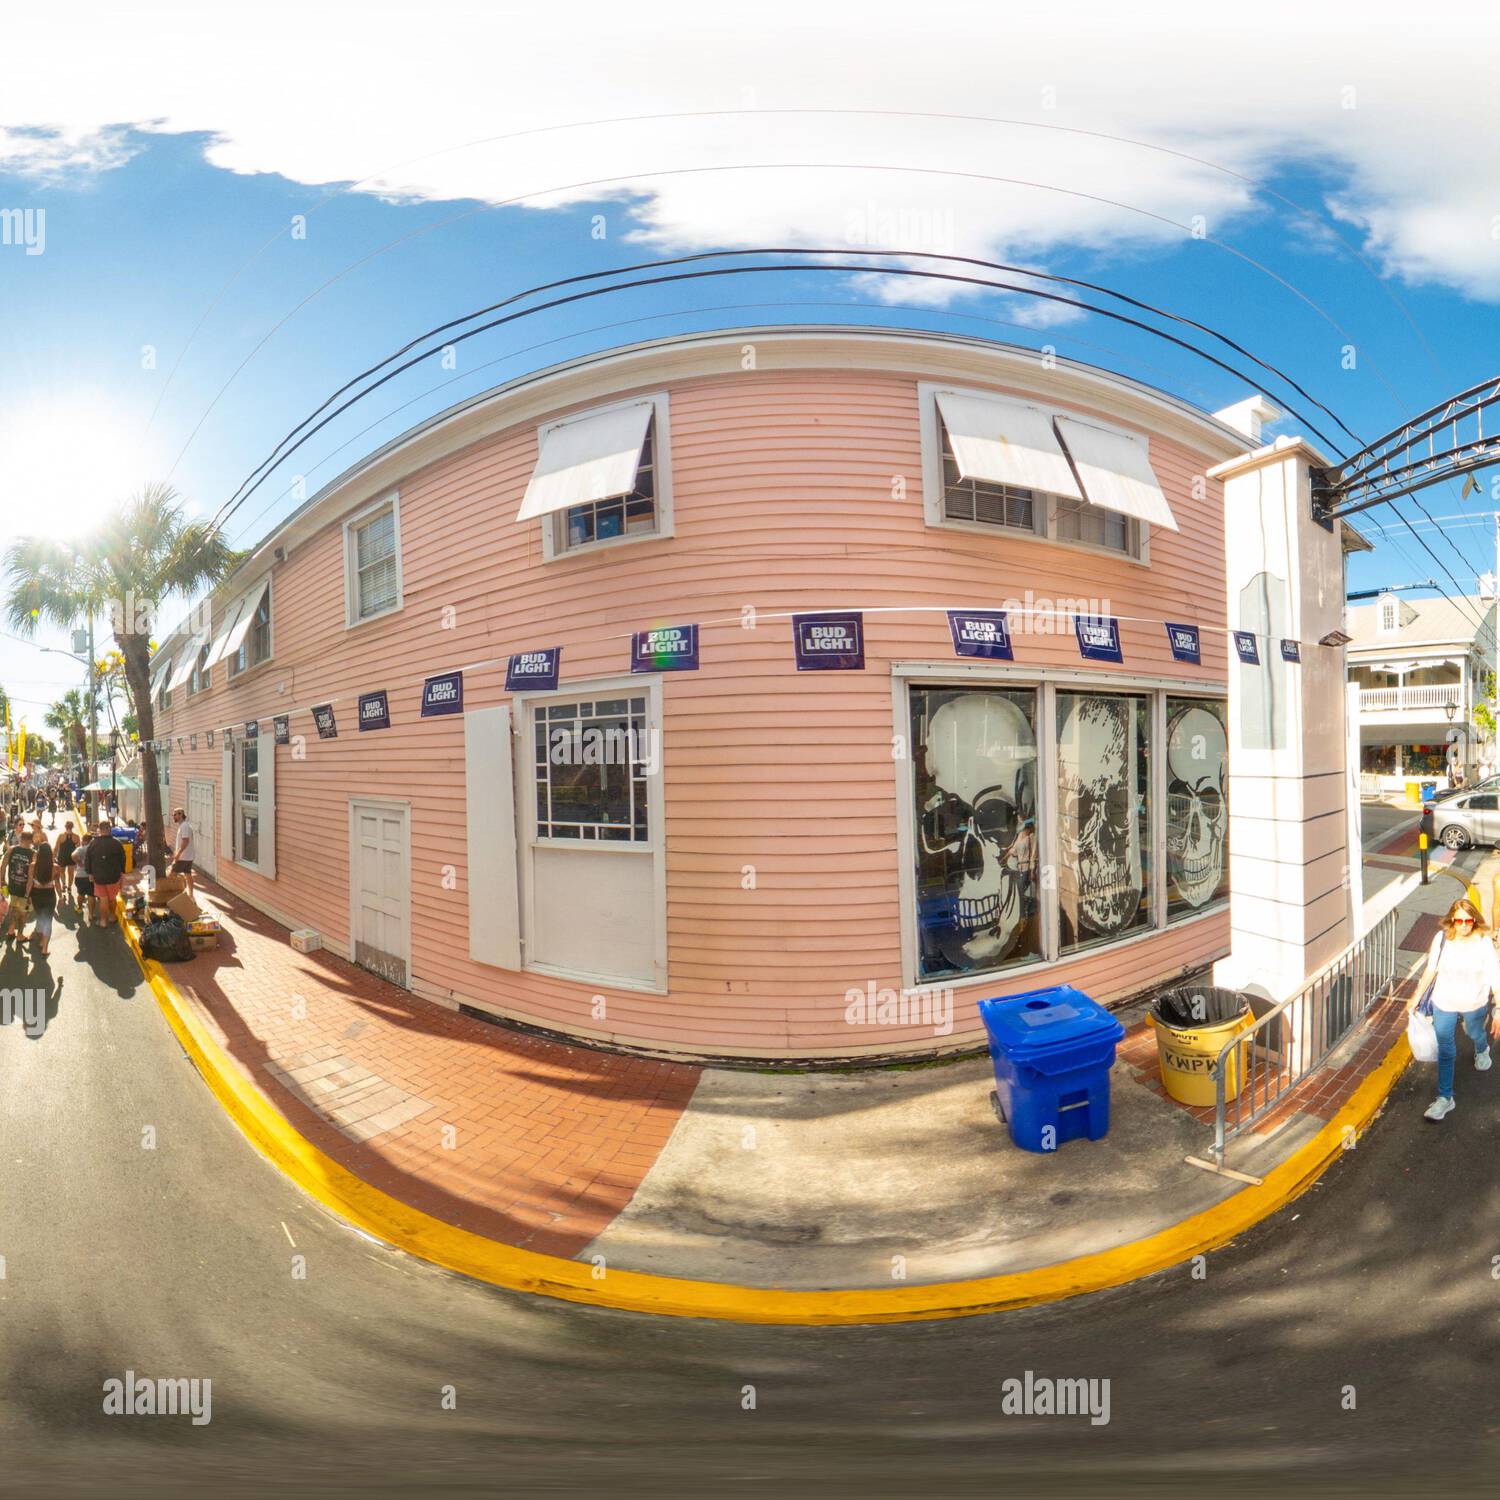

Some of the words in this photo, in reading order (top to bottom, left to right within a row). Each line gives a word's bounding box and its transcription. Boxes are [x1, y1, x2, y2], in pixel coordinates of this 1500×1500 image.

[965, 621, 996, 632] BUD
[1086, 626, 1108, 638] BUD
[648, 629, 681, 642] BUD
[811, 627, 846, 638] BUD
[961, 629, 1002, 642] LIGHT
[1176, 633, 1192, 641] BUD
[806, 638, 853, 650] LIGHT
[1083, 634, 1114, 647] LIGHT
[1175, 640, 1196, 650] LIGHT
[641, 640, 688, 654] LIGHT
[520, 653, 546, 664] BUD
[514, 662, 550, 674] LIGHT
[432, 682, 452, 693] BUD
[428, 690, 456, 701] LIGHT
[366, 701, 380, 710] BUD
[363, 708, 384, 719] LIGHT
[319, 719, 332, 728] LIGHT
